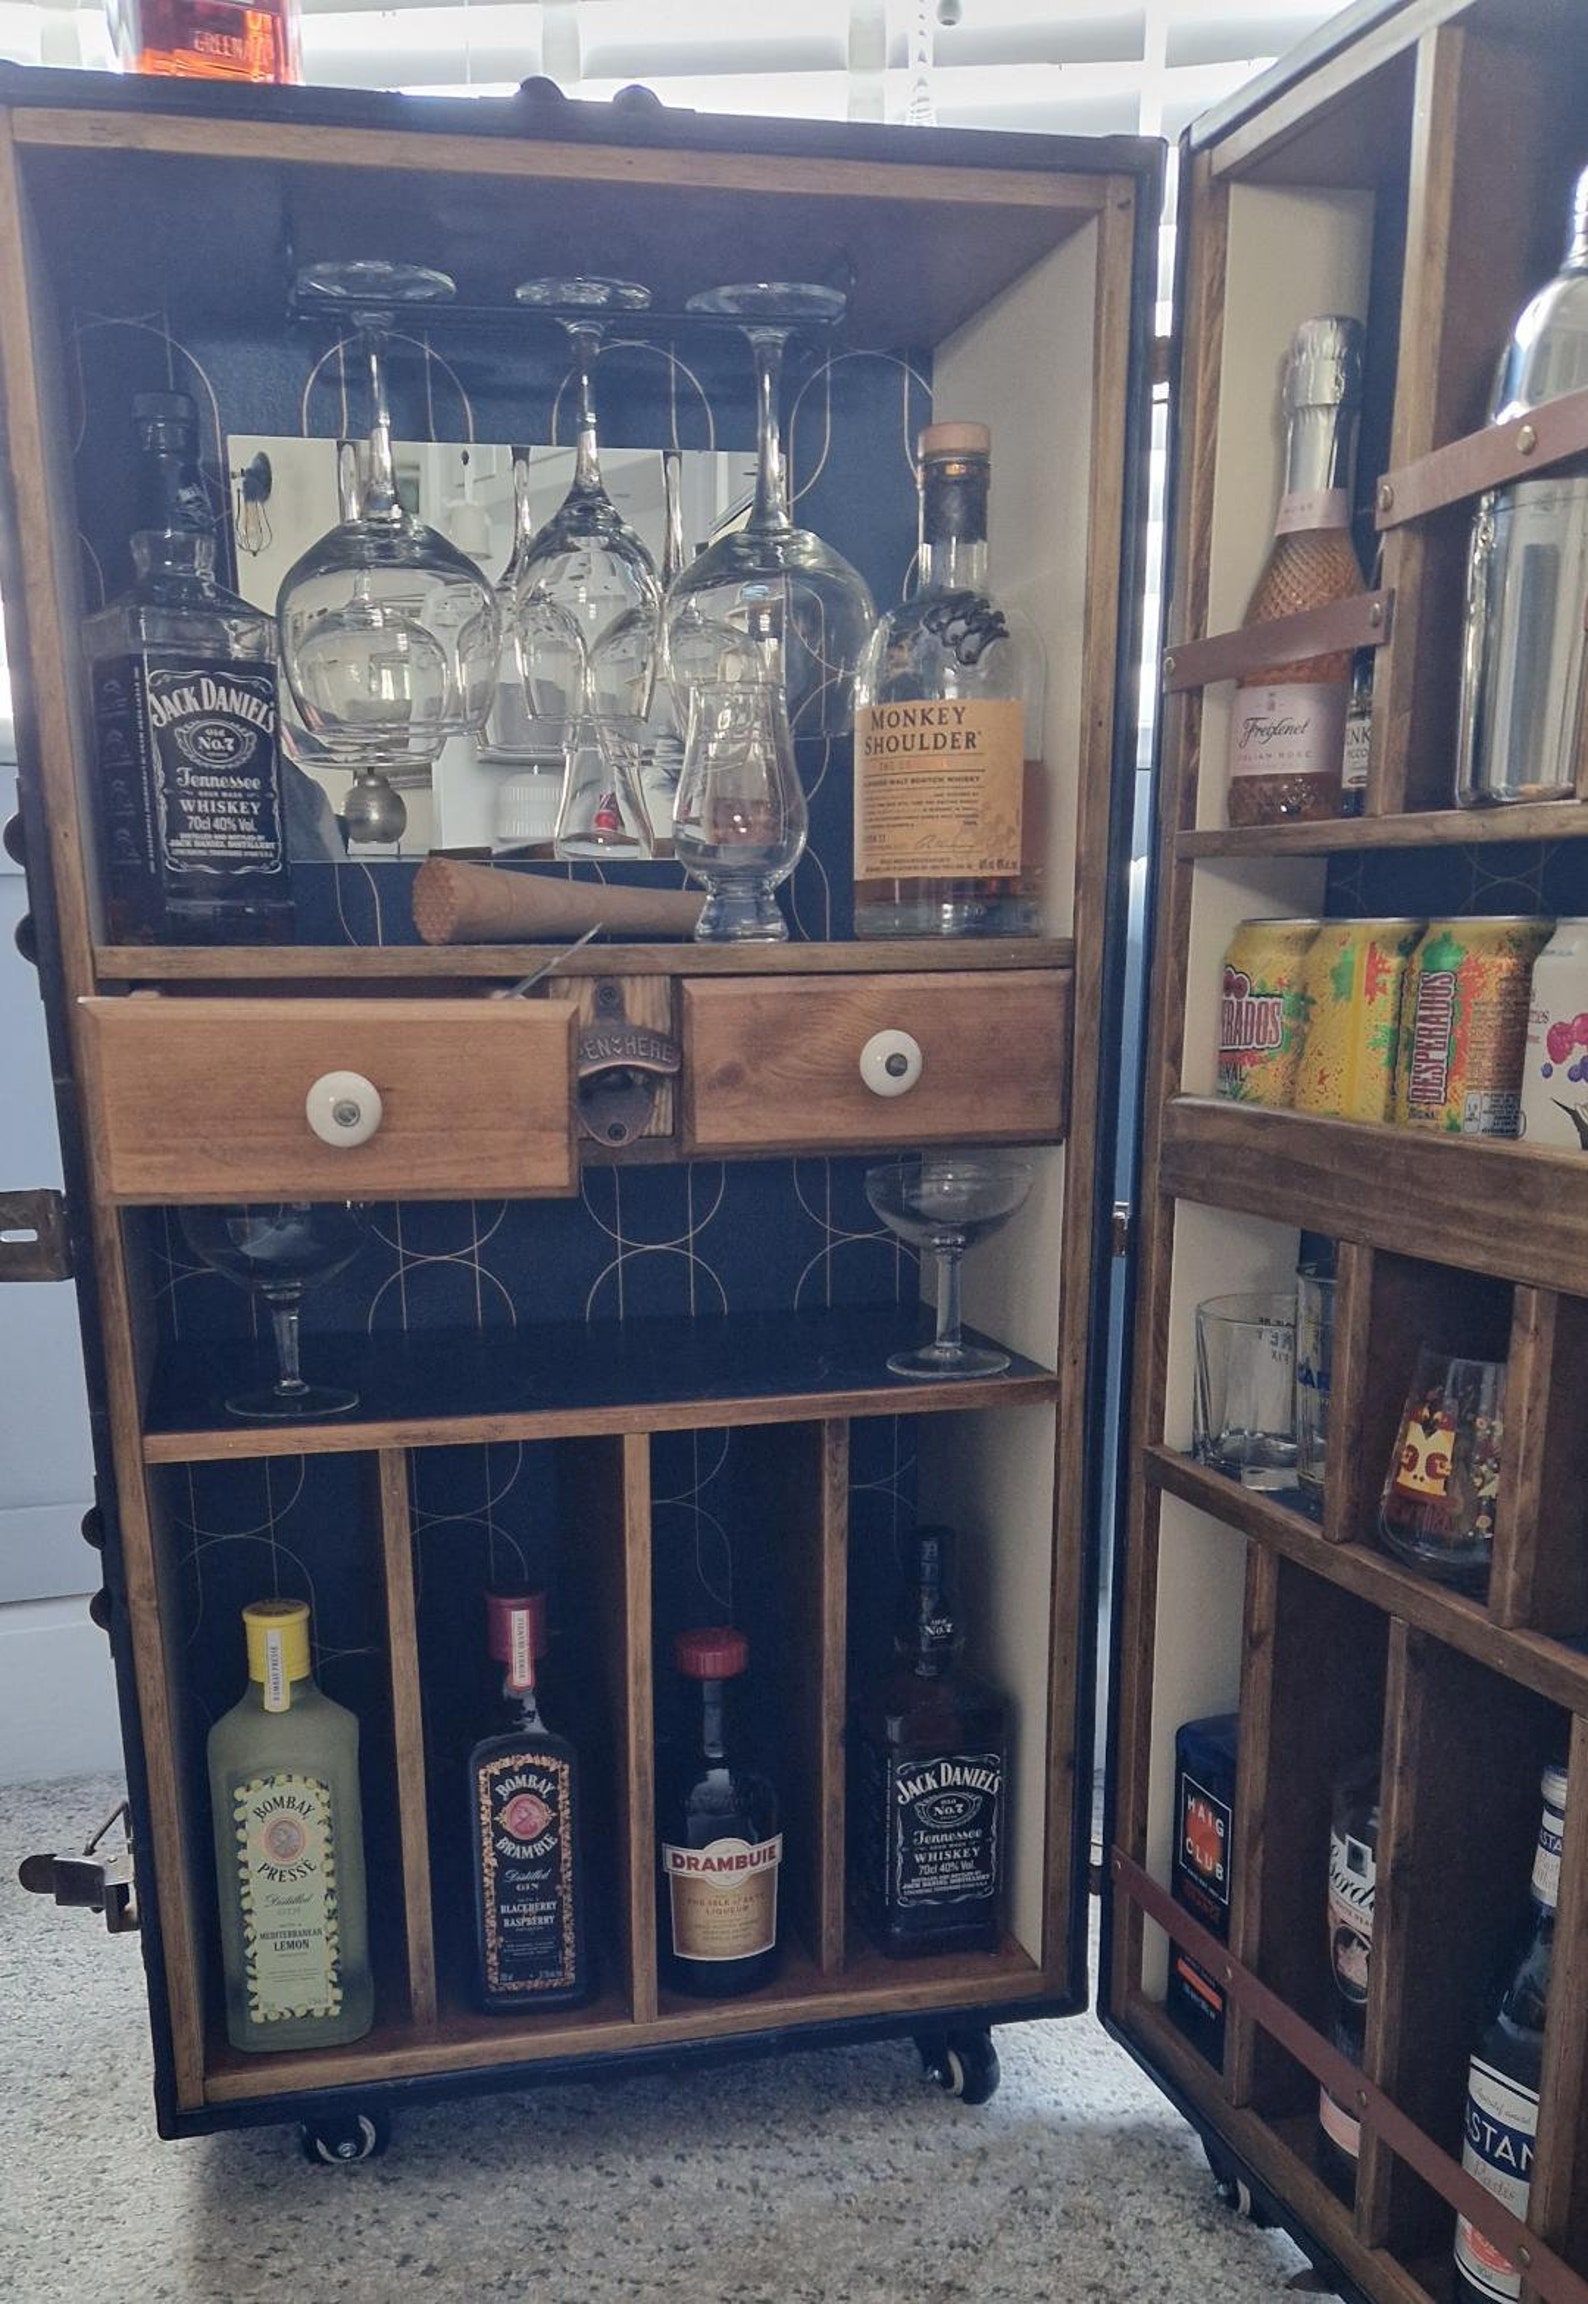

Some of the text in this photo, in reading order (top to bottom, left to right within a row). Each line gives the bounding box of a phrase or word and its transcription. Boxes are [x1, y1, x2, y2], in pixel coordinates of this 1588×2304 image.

[151, 677, 276, 734] JACK DANIEL'S
[871, 706, 967, 732] MONKEY
[198, 735, 236, 752] No.7
[864, 731, 979, 756] SHOULDER
[175, 766, 262, 790] Tennessee
[179, 799, 261, 815] WHISKEY
[187, 816, 211, 831] 70cl
[213, 816, 237, 832] 40%
[1409, 970, 1452, 1104] DESPERADOS
[579, 1035, 673, 1063] EN HERE
[495, 1774, 555, 1799] BOMBAY
[895, 1762, 1002, 1805] JACK DANIEL'S
[252, 1796, 316, 1821] BOMBAY
[932, 1803, 964, 1817] No.7
[1186, 1794, 1225, 1838] HAIG
[495, 1835, 558, 1860] BRAMBLE
[913, 1828, 983, 1846] Tennessee
[671, 1845, 776, 1872] DRAMBUIE
[914, 1846, 981, 1864] WHISKEY
[1185, 1837, 1225, 1882] CLUB
[503, 1868, 552, 1883] Distilled
[918, 1864, 938, 1876] 70cl
[939, 1863, 959, 1874] 40%
[515, 1883, 539, 1892] GIN
[500, 1901, 557, 1914] BLACKBERRY
[503, 1915, 555, 1928] RASPBERRY
[259, 1928, 323, 1940] MEDITERRANEAN
[274, 1939, 310, 1952] LEMON
